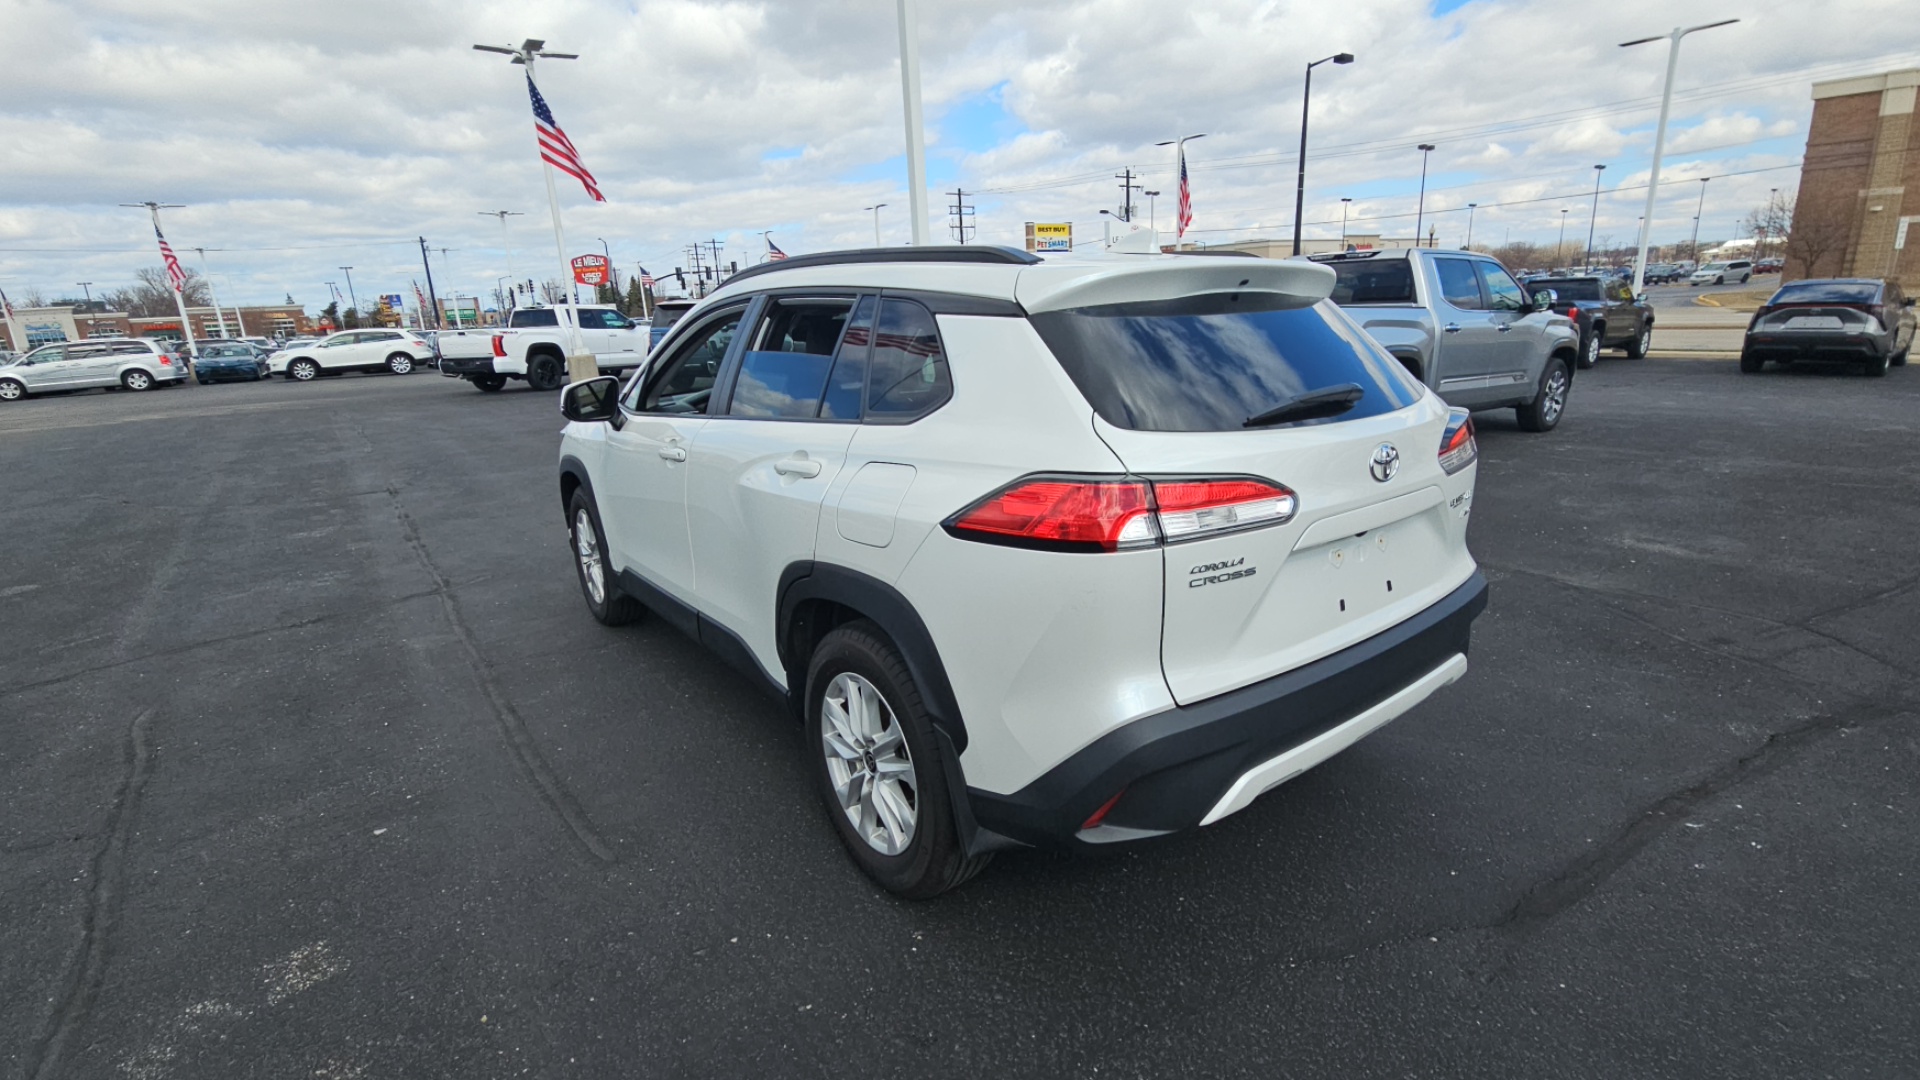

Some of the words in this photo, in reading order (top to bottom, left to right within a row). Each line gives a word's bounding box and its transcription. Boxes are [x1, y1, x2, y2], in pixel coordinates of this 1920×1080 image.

[1037, 240, 1068, 248] PETSMART
[573, 258, 583, 267] LE
[582, 255, 605, 266] MIEUX
[1189, 557, 1244, 574] COROLLA
[1189, 567, 1256, 588] CROSS
